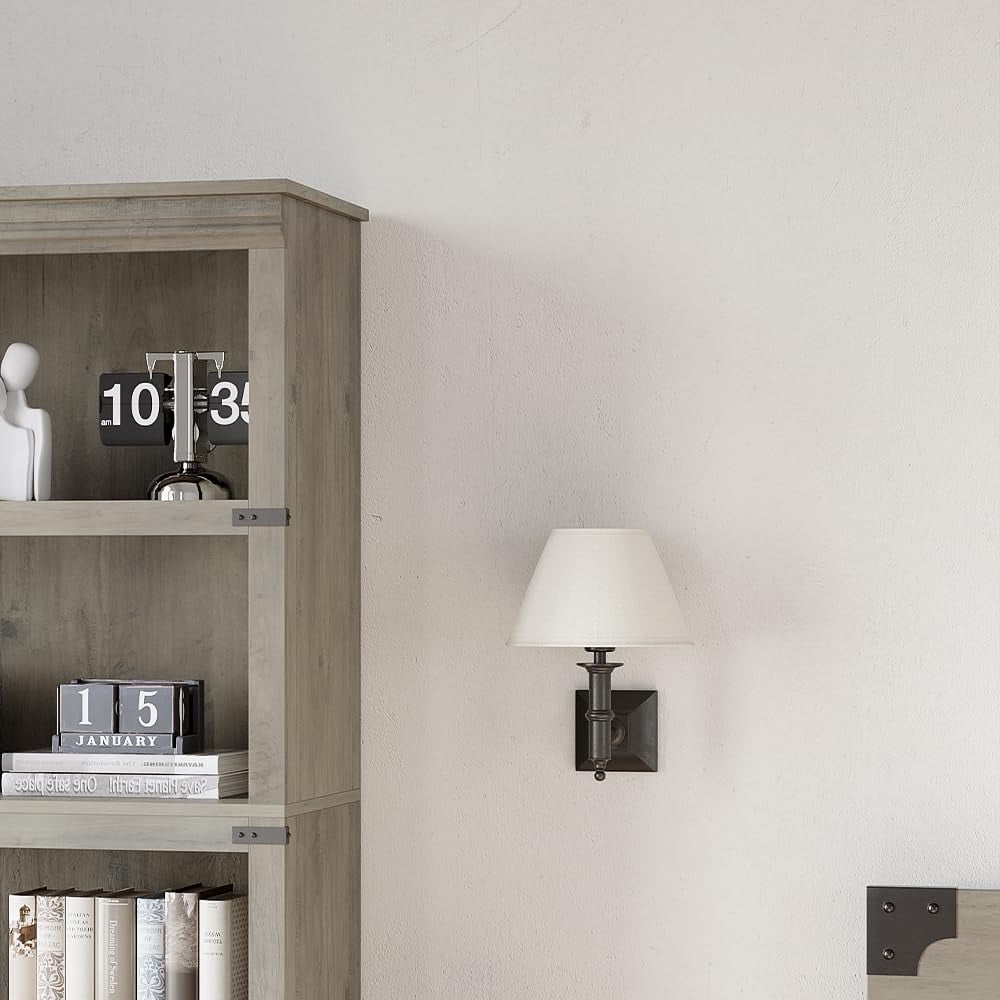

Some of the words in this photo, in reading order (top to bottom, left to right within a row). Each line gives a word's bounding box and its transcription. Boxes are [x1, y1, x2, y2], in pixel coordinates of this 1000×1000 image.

[103, 382, 160, 426] 10
[77, 687, 93, 726] 1
[138, 690, 158, 728] 5
[75, 735, 159, 747] JANUARY
